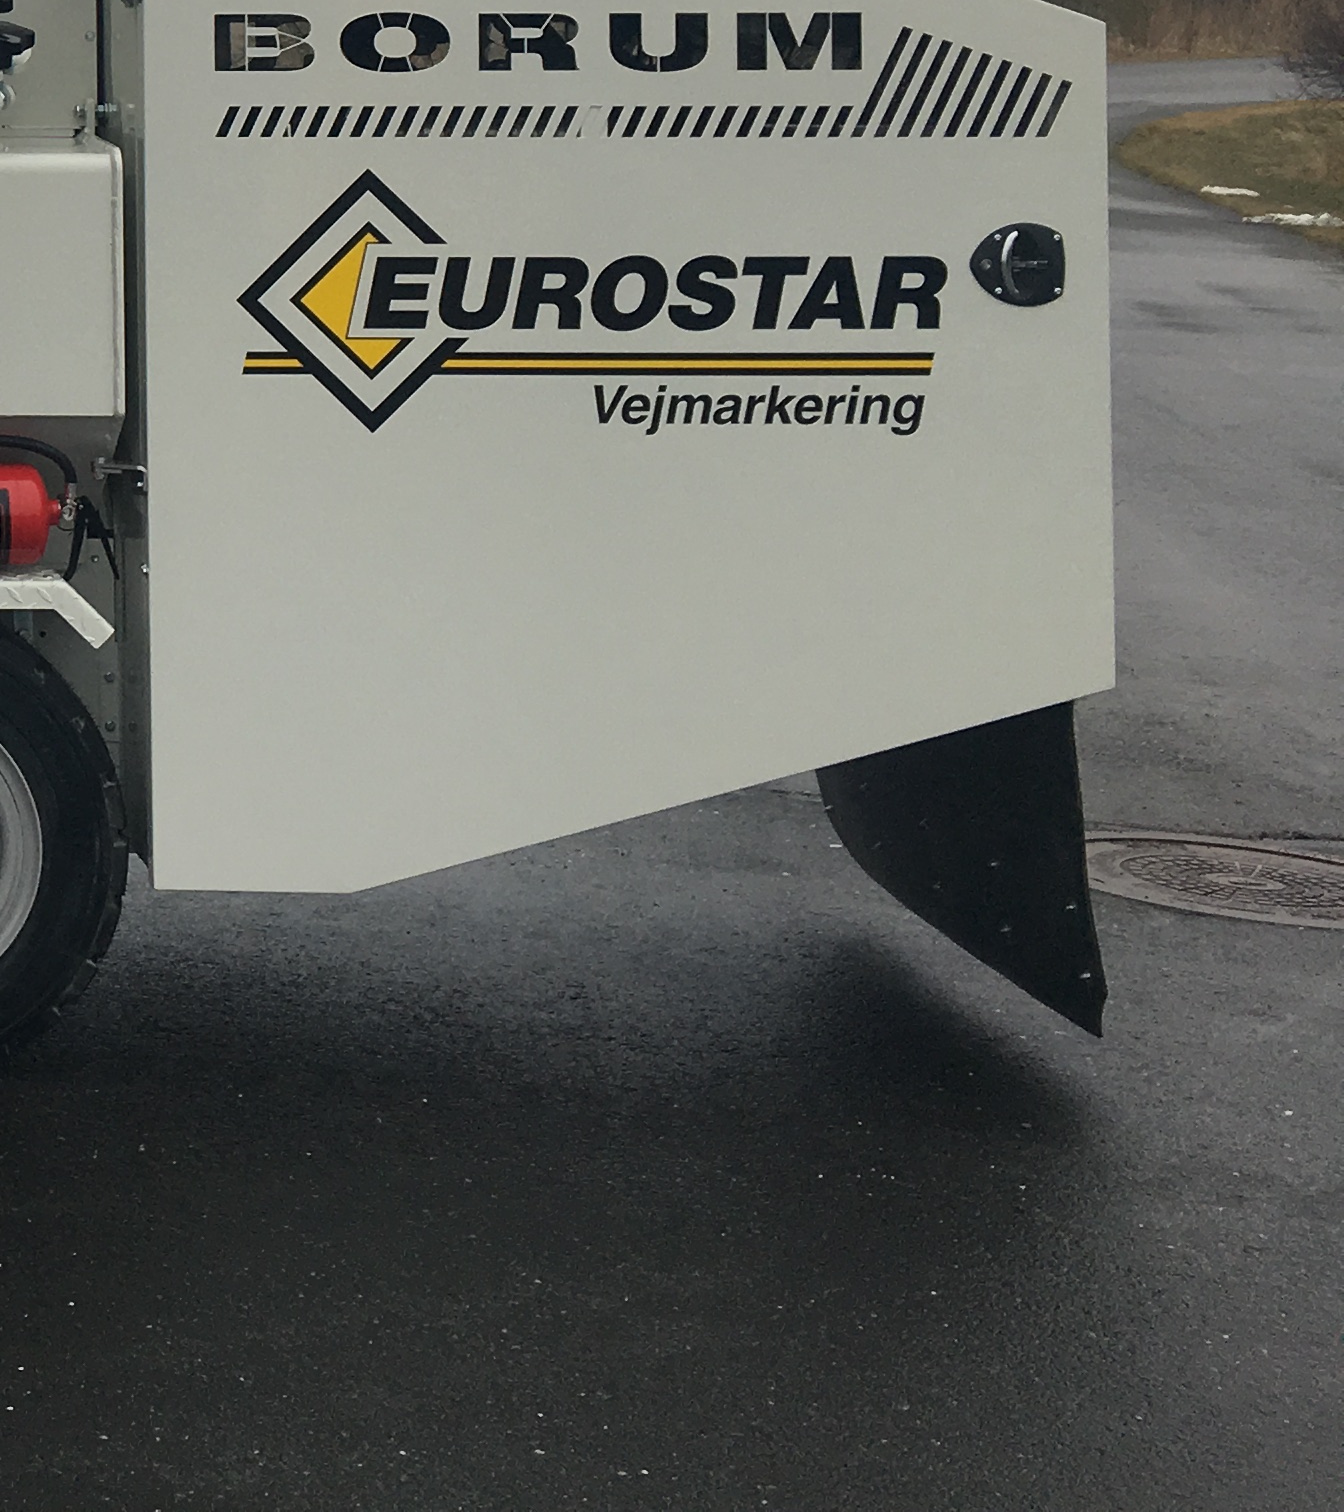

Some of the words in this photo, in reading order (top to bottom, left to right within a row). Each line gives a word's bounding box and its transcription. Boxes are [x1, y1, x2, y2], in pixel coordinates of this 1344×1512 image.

[214, 12, 862, 72] BORUM
[363, 255, 947, 331] EUROSTAR
[594, 385, 925, 435] Vejmarkering
